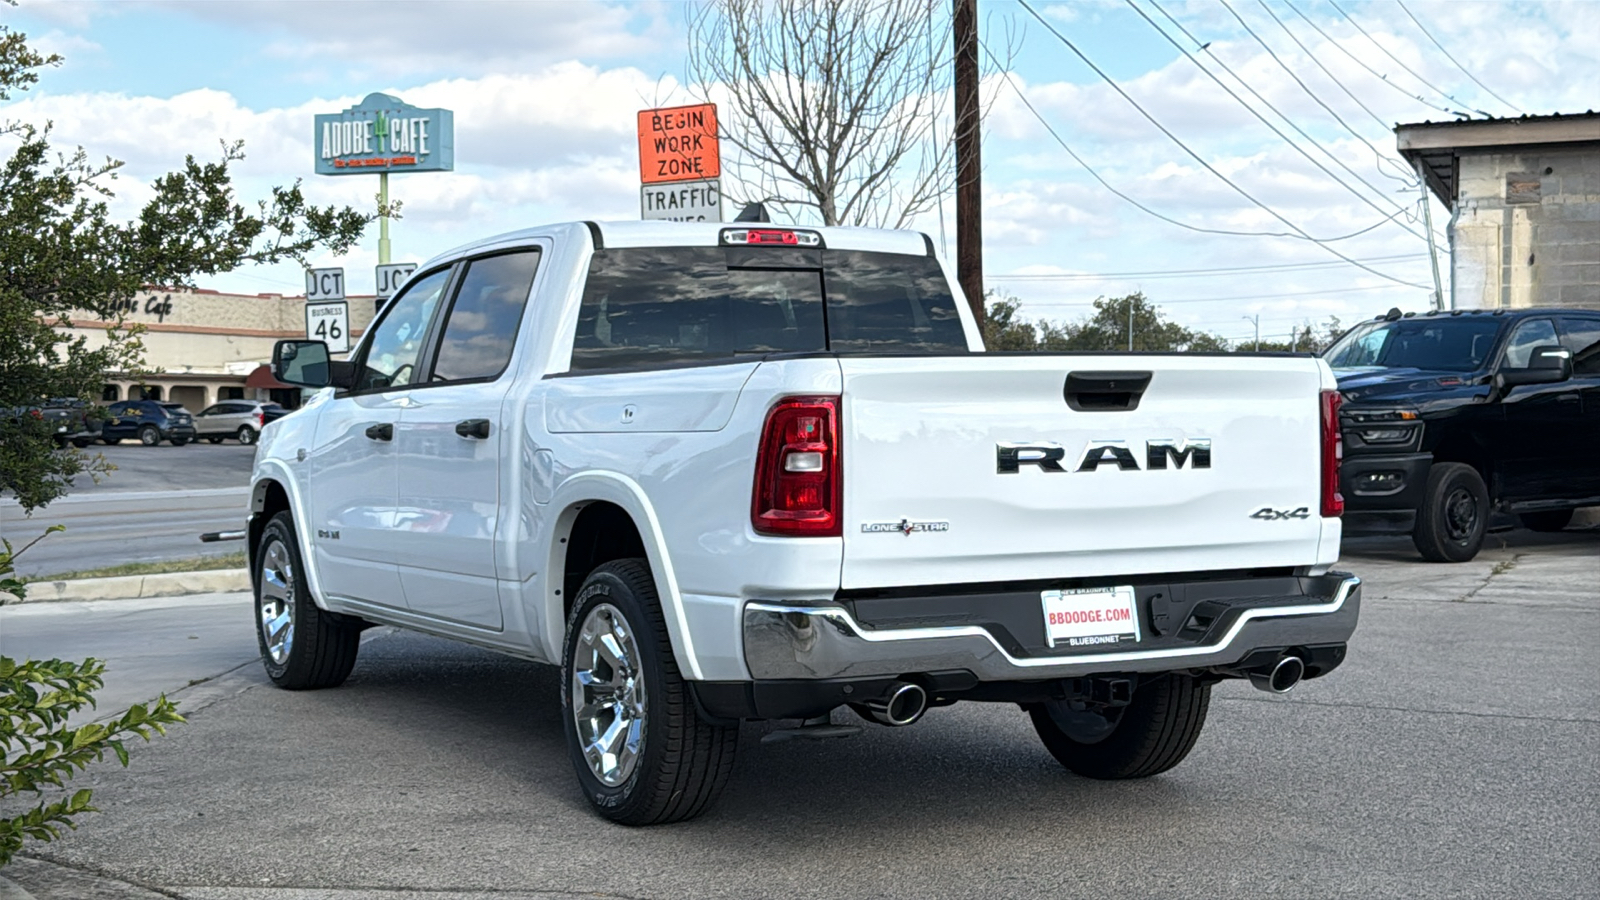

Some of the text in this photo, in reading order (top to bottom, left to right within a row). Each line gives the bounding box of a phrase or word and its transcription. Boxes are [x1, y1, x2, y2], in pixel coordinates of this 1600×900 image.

[652, 111, 703, 131] BEGIN
[322, 117, 430, 158] ADOBE CAFE
[654, 134, 703, 153] WORK
[658, 157, 703, 176] ZONE
[646, 187, 717, 210] TRAFFIC
[309, 273, 341, 296] JCT
[312, 307, 342, 317] BUSINESS
[315, 319, 341, 339] 46
[996, 438, 1212, 474] RAM
[861, 522, 950, 533] LONE STAR
[1049, 608, 1130, 625] BBDODGE.COM
[1070, 635, 1120, 646] BLUEBONNET
